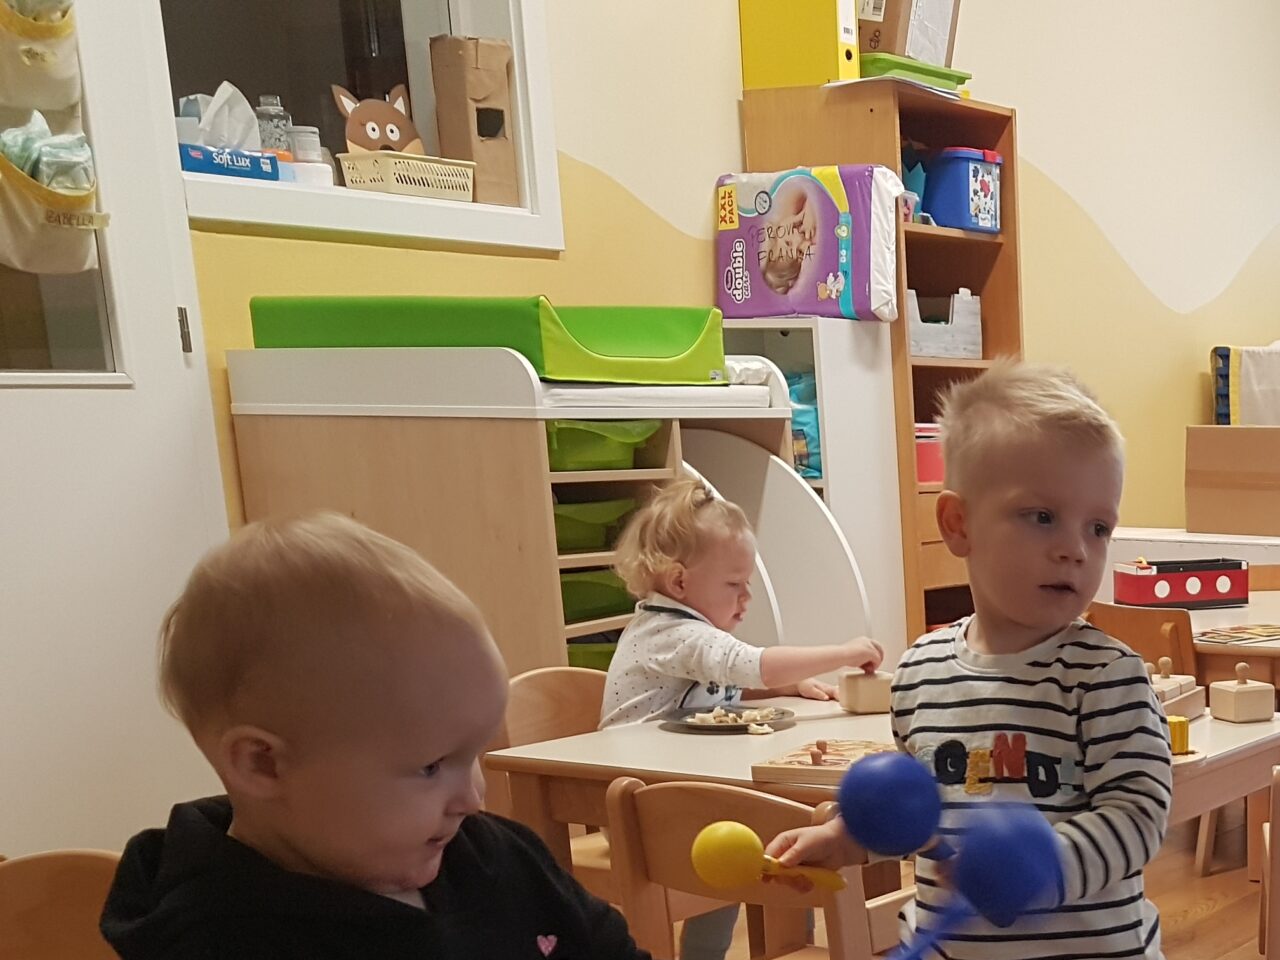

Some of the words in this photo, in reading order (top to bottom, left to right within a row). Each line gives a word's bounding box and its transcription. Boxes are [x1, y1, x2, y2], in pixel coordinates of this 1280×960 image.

[212, 152, 232, 168] Soft
[233, 155, 251, 168] Lux
[719, 189, 727, 225] XXL
[732, 241, 744, 301] double
